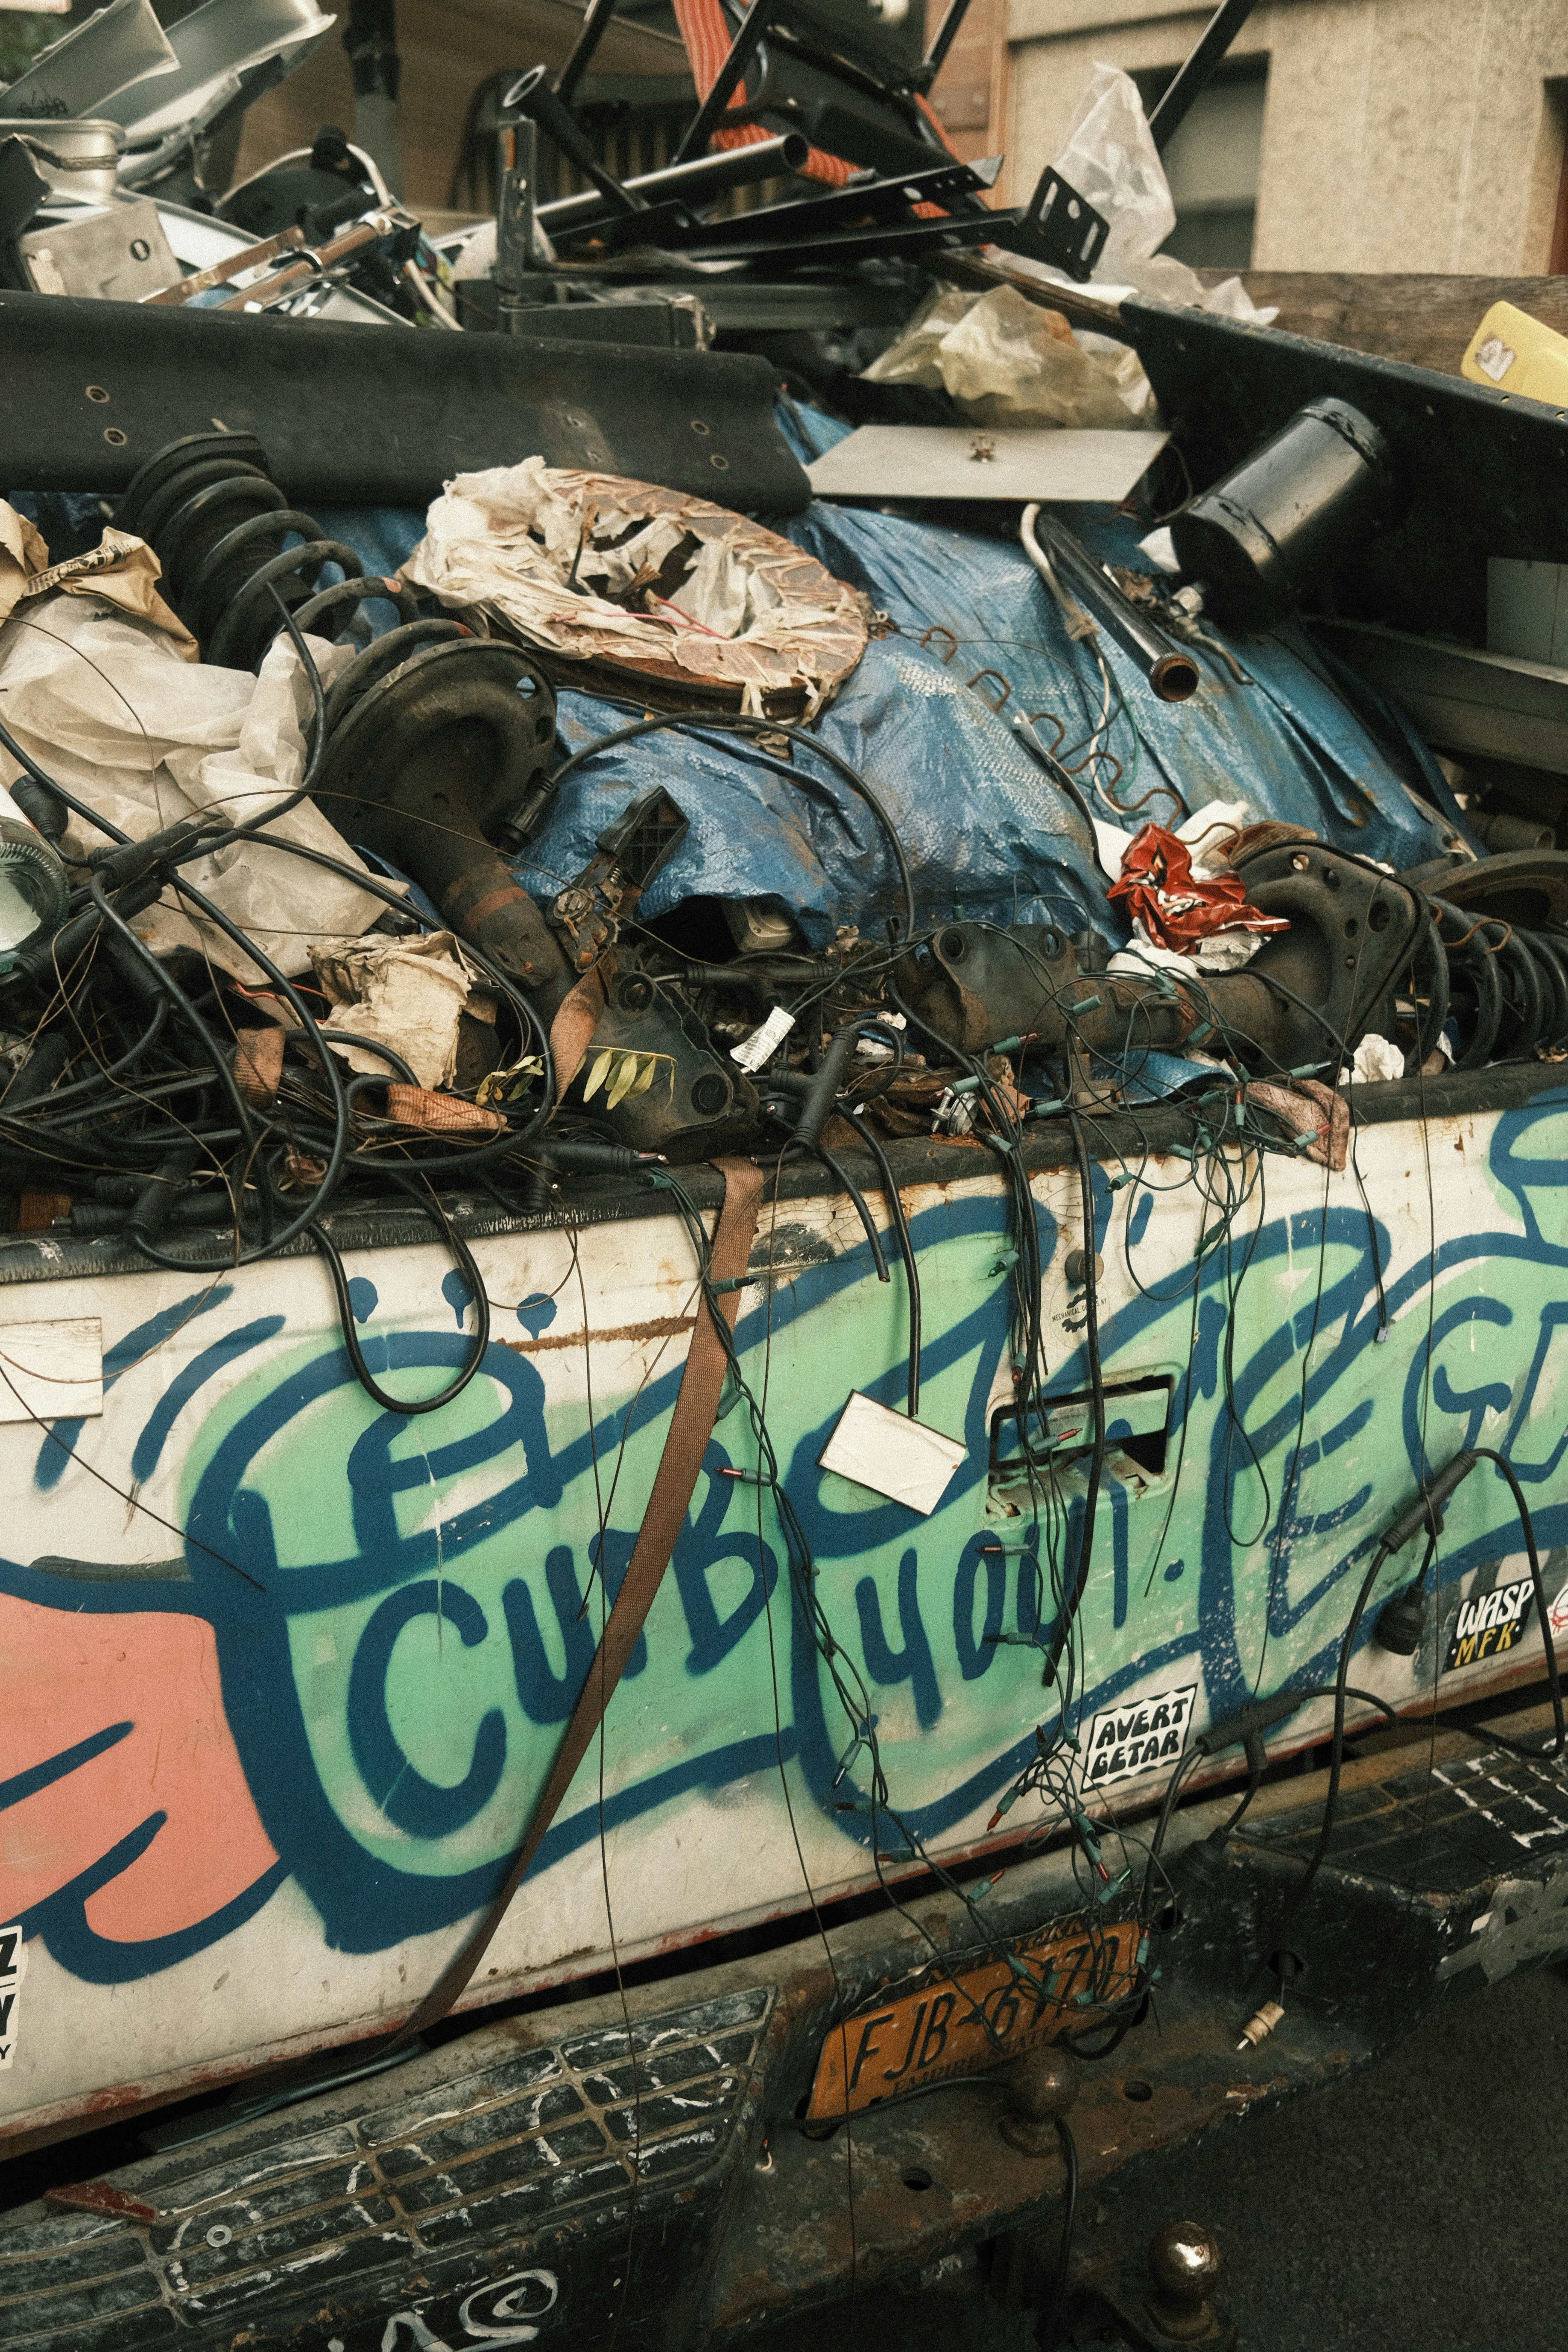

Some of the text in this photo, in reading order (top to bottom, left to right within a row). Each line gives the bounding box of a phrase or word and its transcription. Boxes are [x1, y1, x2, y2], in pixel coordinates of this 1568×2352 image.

[1456, 1579, 1535, 1639] WASP
[1096, 1697, 1188, 1749] AVERT
[1091, 1729, 1179, 1779] GETAR
